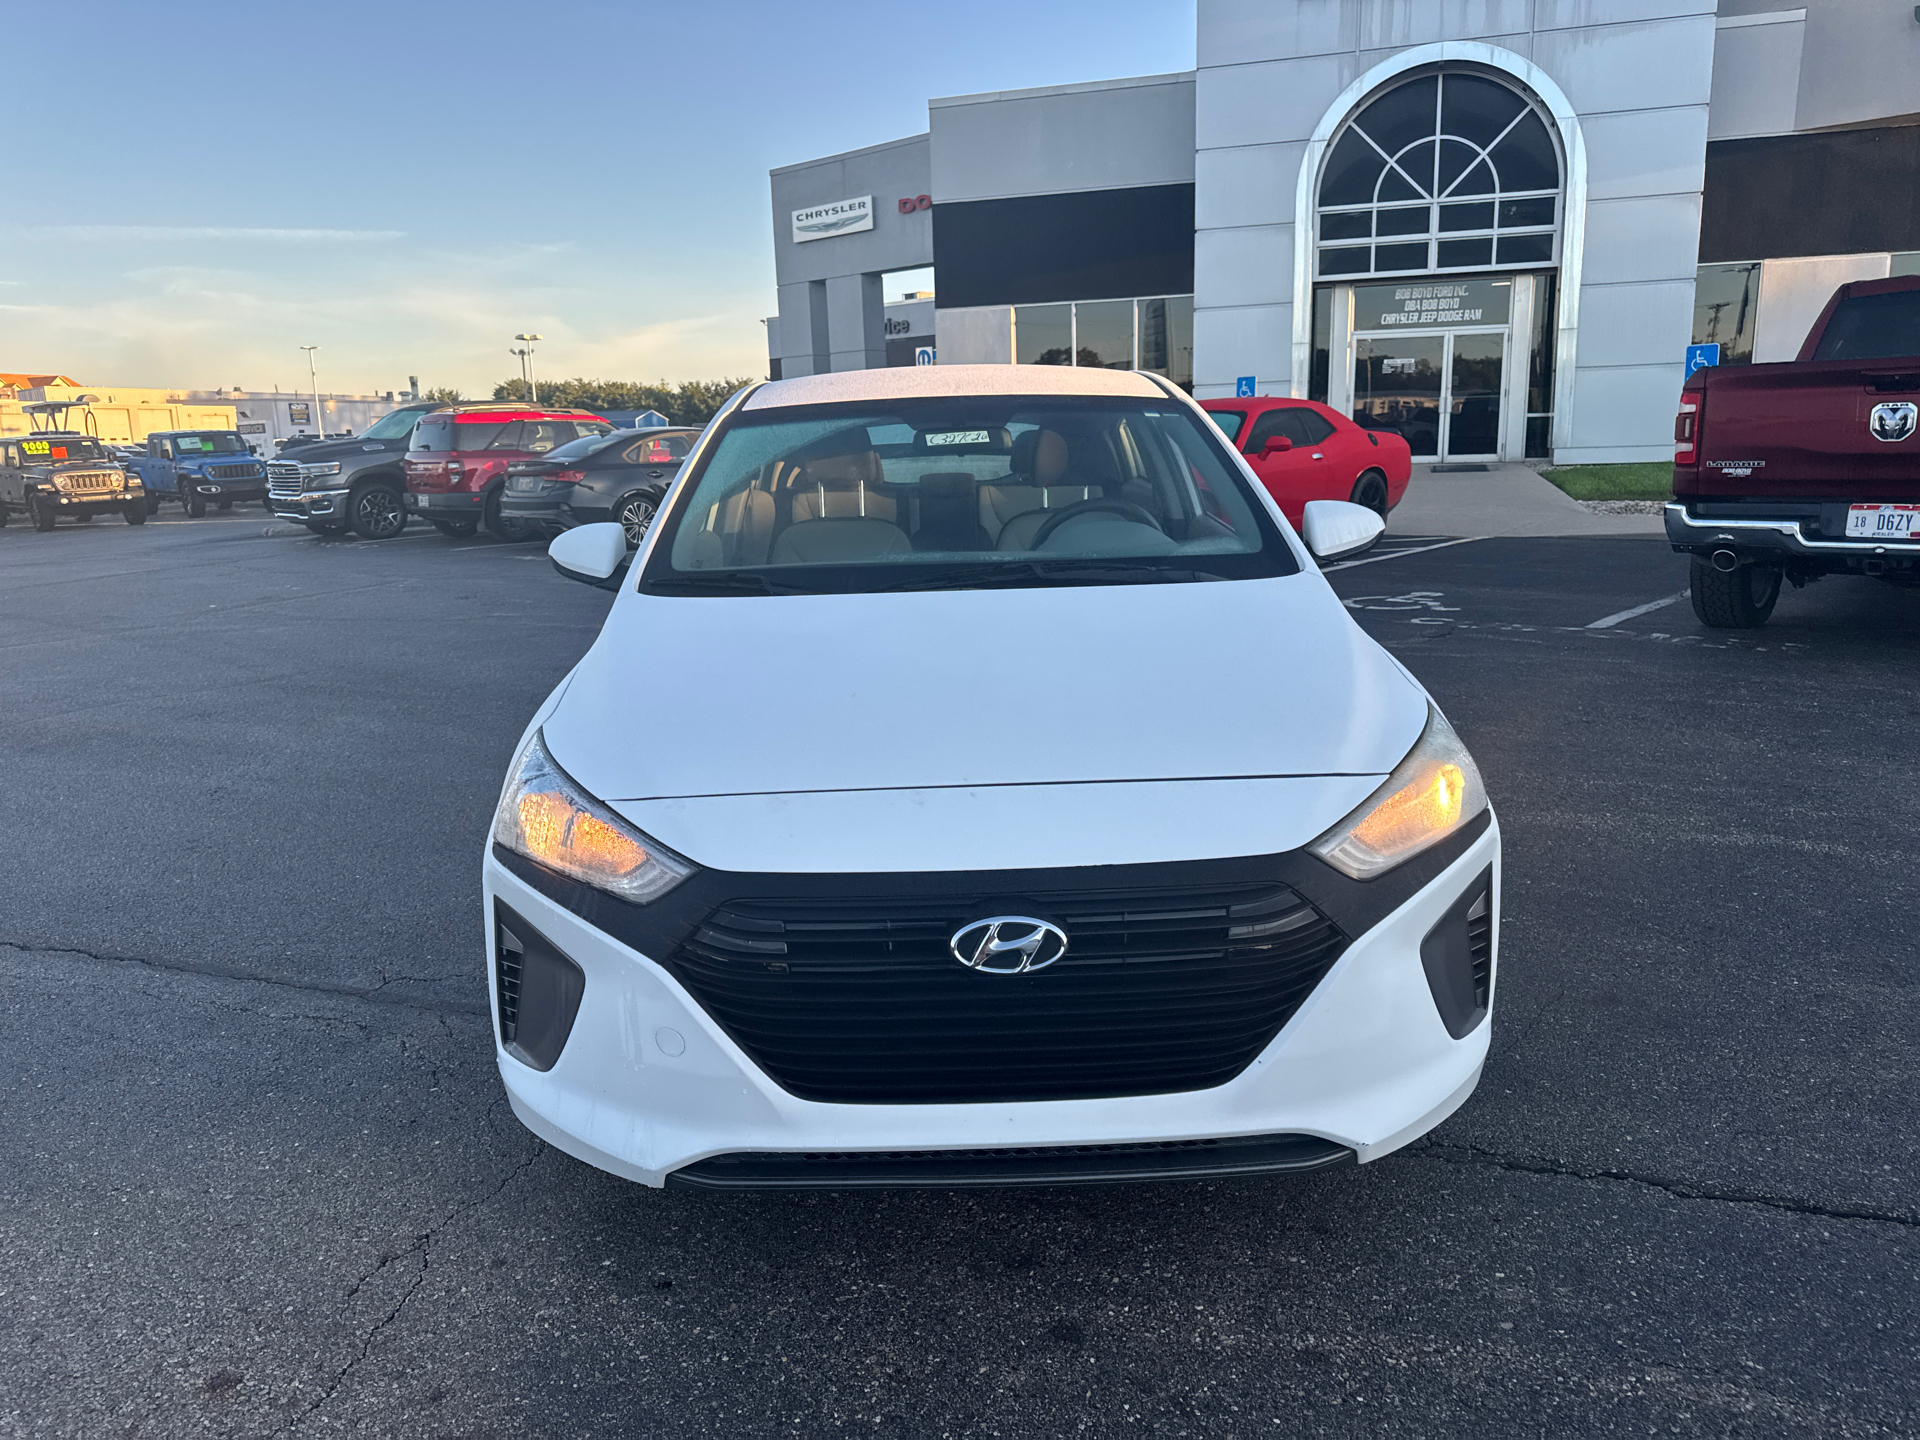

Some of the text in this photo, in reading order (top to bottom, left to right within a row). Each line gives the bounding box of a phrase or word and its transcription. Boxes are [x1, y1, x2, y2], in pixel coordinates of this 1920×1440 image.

[796, 201, 867, 222] CHRYSLER
[1395, 288, 1412, 299] BOB
[1412, 287, 1433, 299] BOYD
[1433, 285, 1454, 298] FORD
[1404, 298, 1460, 311] DBA BOB BOYD
[1381, 309, 1483, 324] CHRYSLER JEEP DODGE RAM
[240, 424, 263, 433] SERVICE
[22, 441, 49, 451] 9000
[1854, 513, 1914, 531] 18 D6ZY
